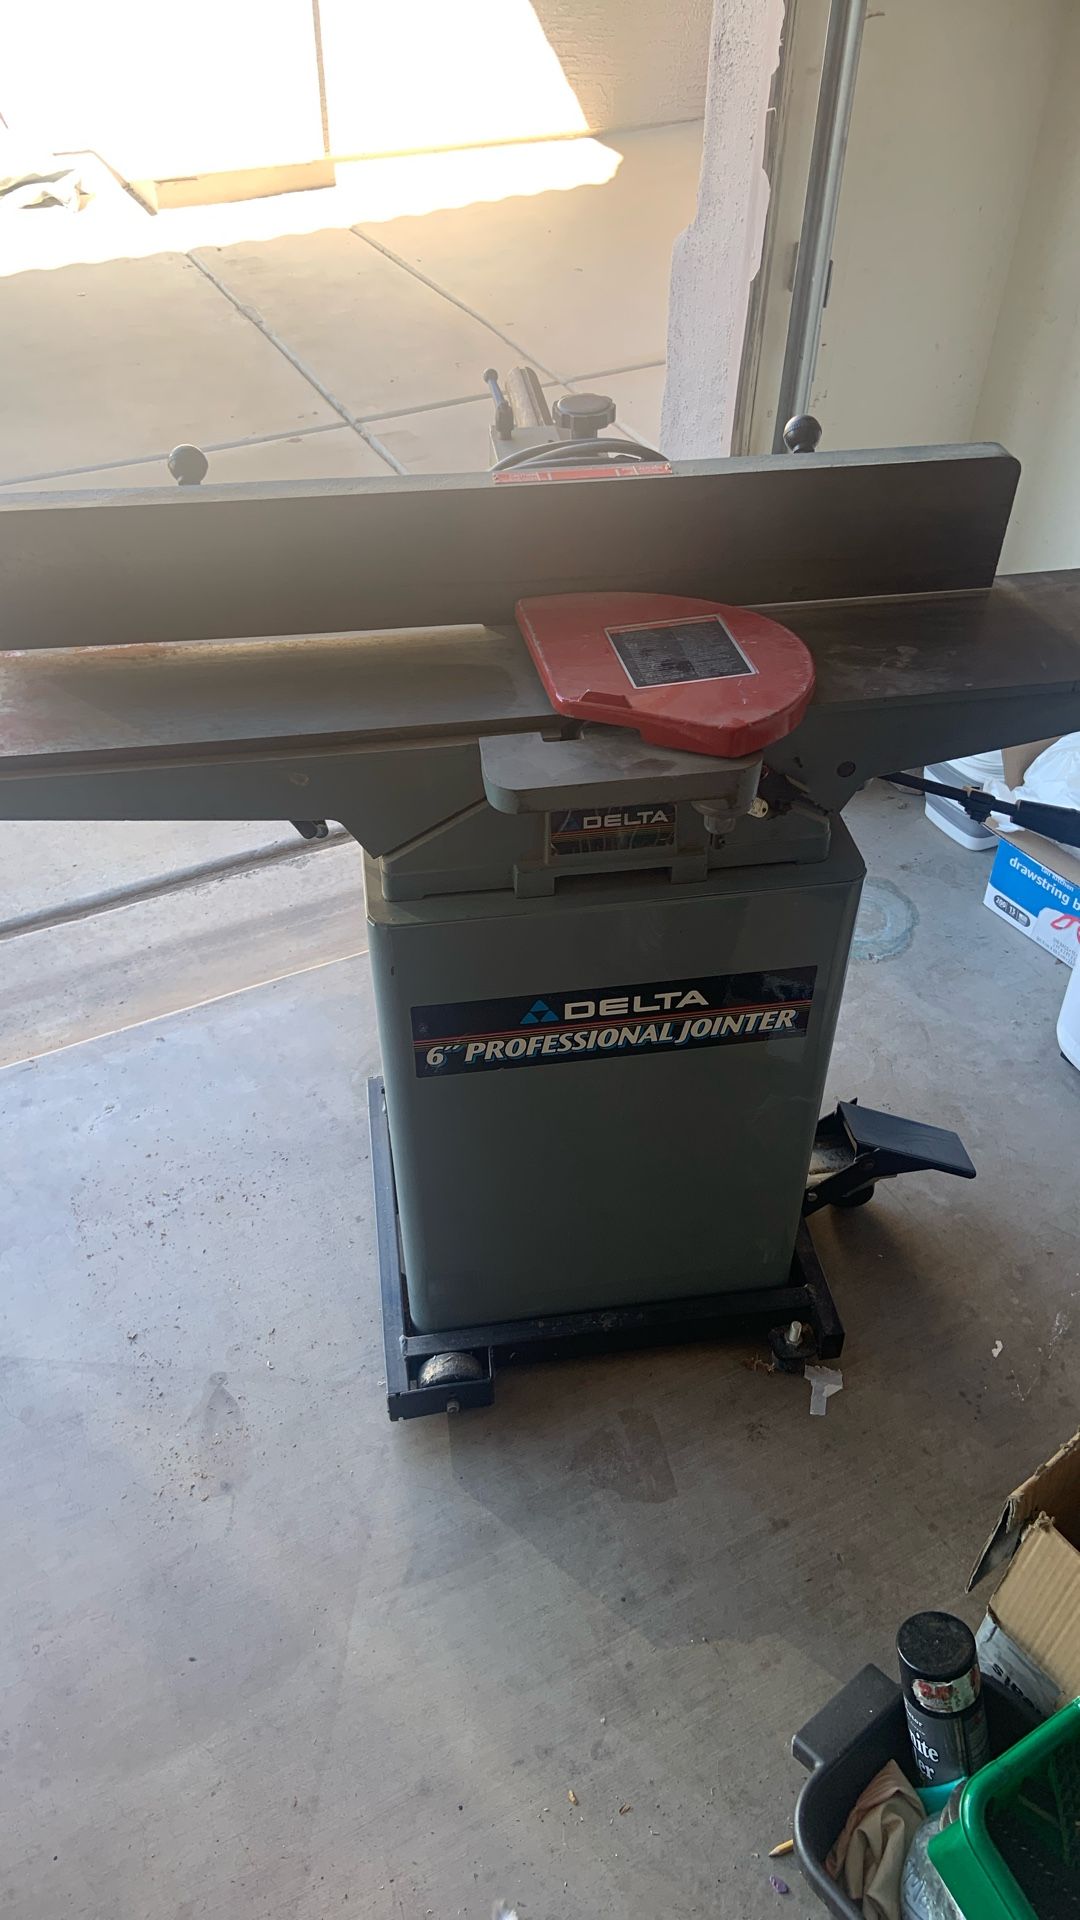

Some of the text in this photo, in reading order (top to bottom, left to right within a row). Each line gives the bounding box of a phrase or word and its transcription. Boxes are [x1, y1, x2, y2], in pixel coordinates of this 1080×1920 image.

[583, 809, 669, 830] DELTA
[1009, 857, 1070, 905] drawstring
[564, 989, 709, 1021] DELTA
[464, 1022, 673, 1064] PROFESSIONAL
[674, 1009, 797, 1045] JOINTER
